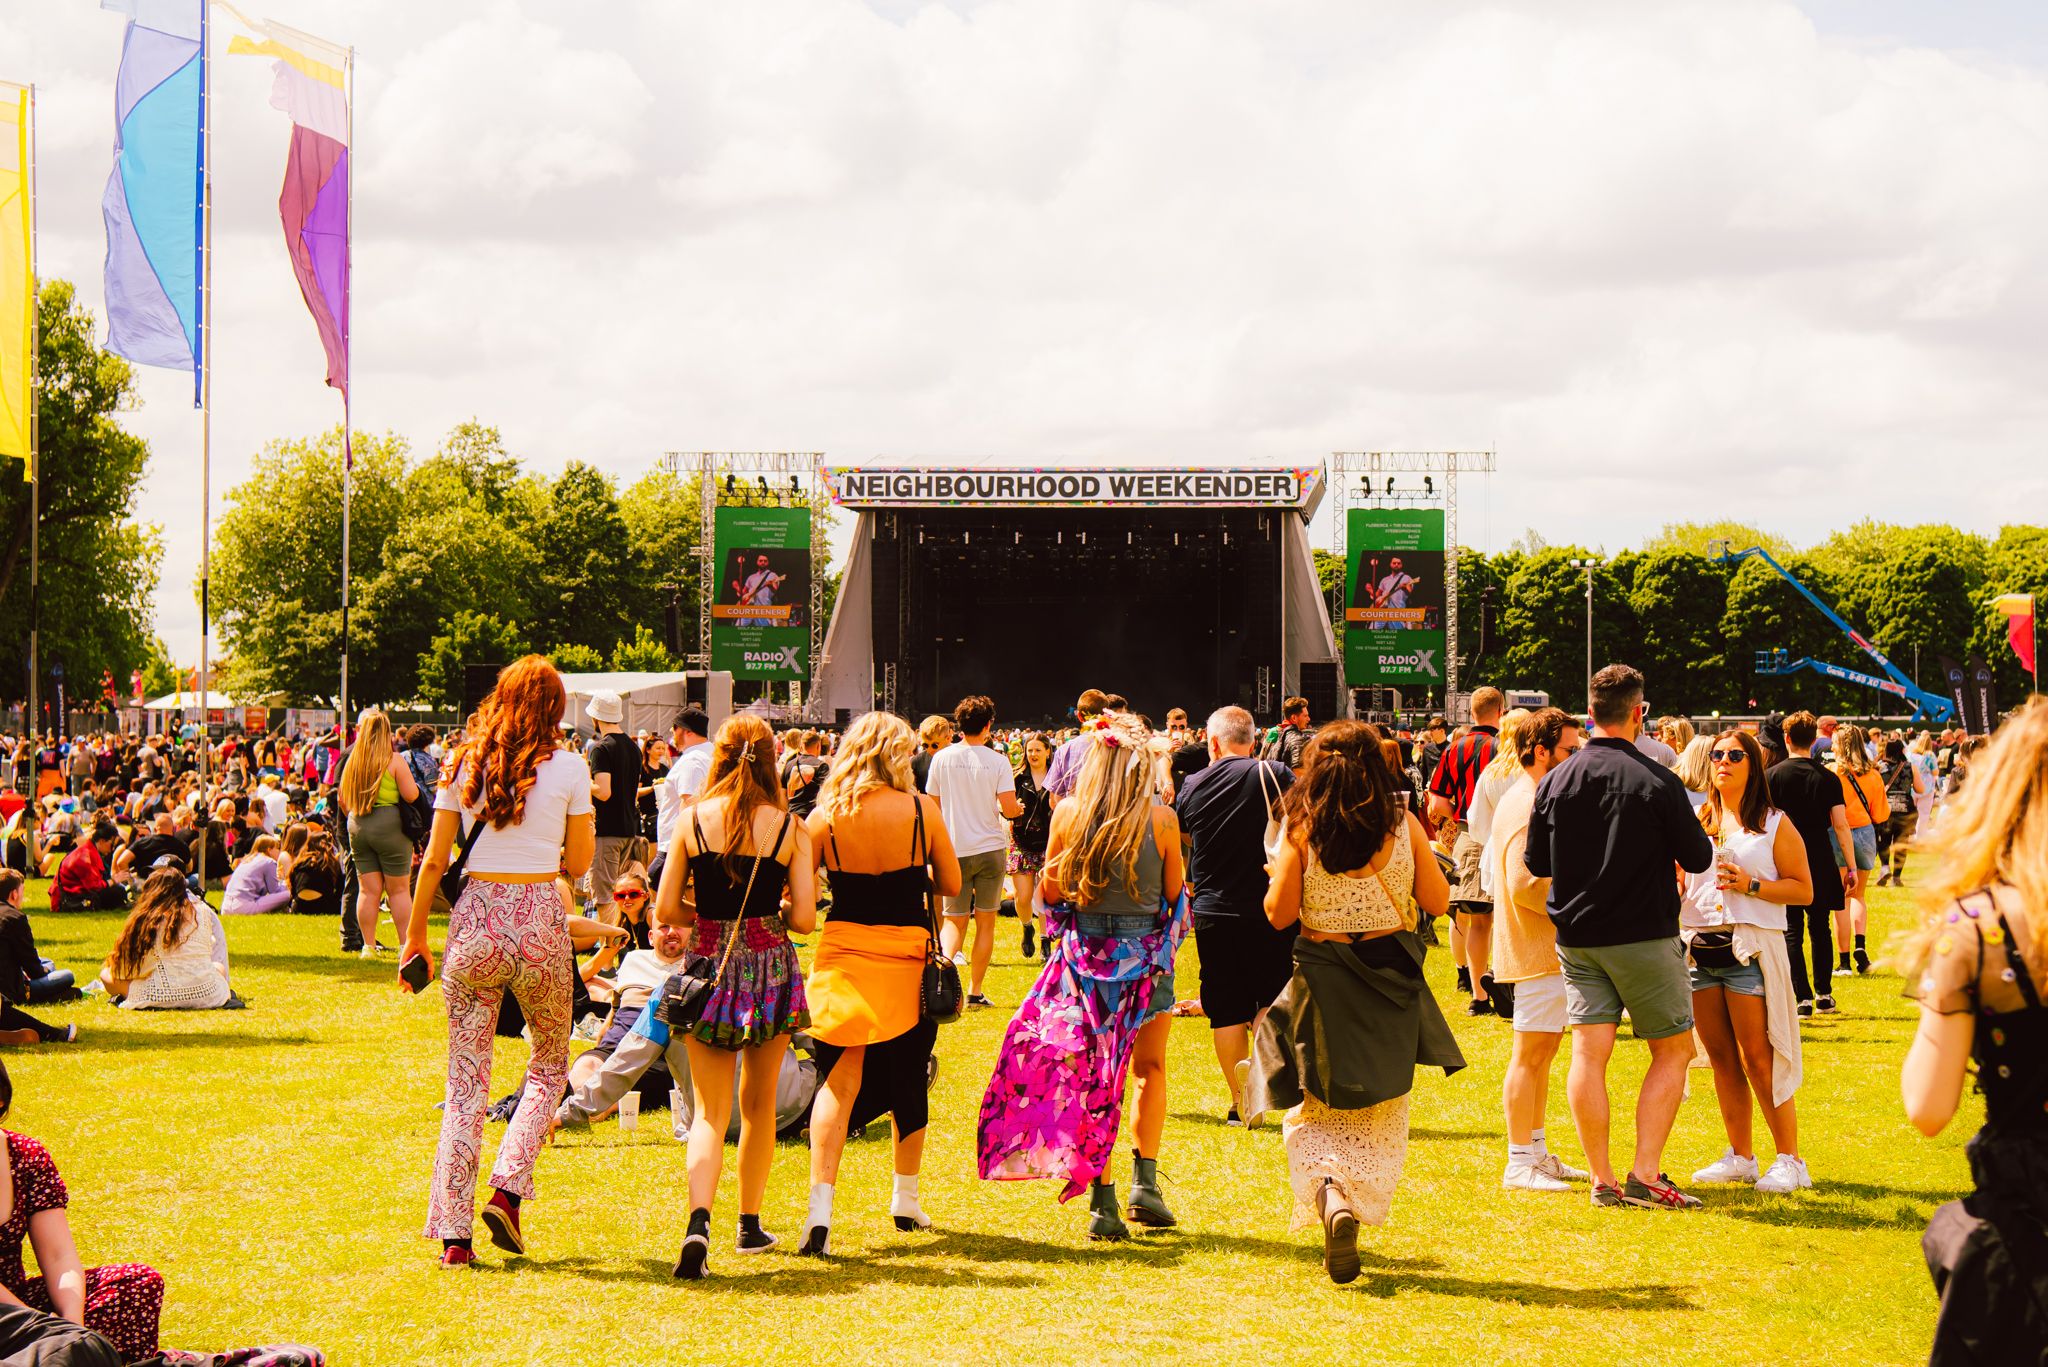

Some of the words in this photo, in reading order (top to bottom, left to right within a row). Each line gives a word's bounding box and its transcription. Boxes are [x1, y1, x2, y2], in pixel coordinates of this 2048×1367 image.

[845, 474, 1101, 500] NEIGHBOURHOOD
[1109, 474, 1293, 499] WEEKENDER
[727, 608, 787, 616] COURTEENERS
[1360, 611, 1421, 619] COURTEENERS
[744, 651, 784, 662] RADIO
[1378, 655, 1418, 665] RADIO
[745, 662, 761, 670] 97.7
[764, 662, 777, 670] FM
[1380, 666, 1396, 674] 97.7
[1398, 666, 1411, 674] FM
[1826, 665, 1846, 678] Genie
[1518, 696, 1542, 704] BUFFALO
[1979, 687, 1989, 727] ENTRANCE
